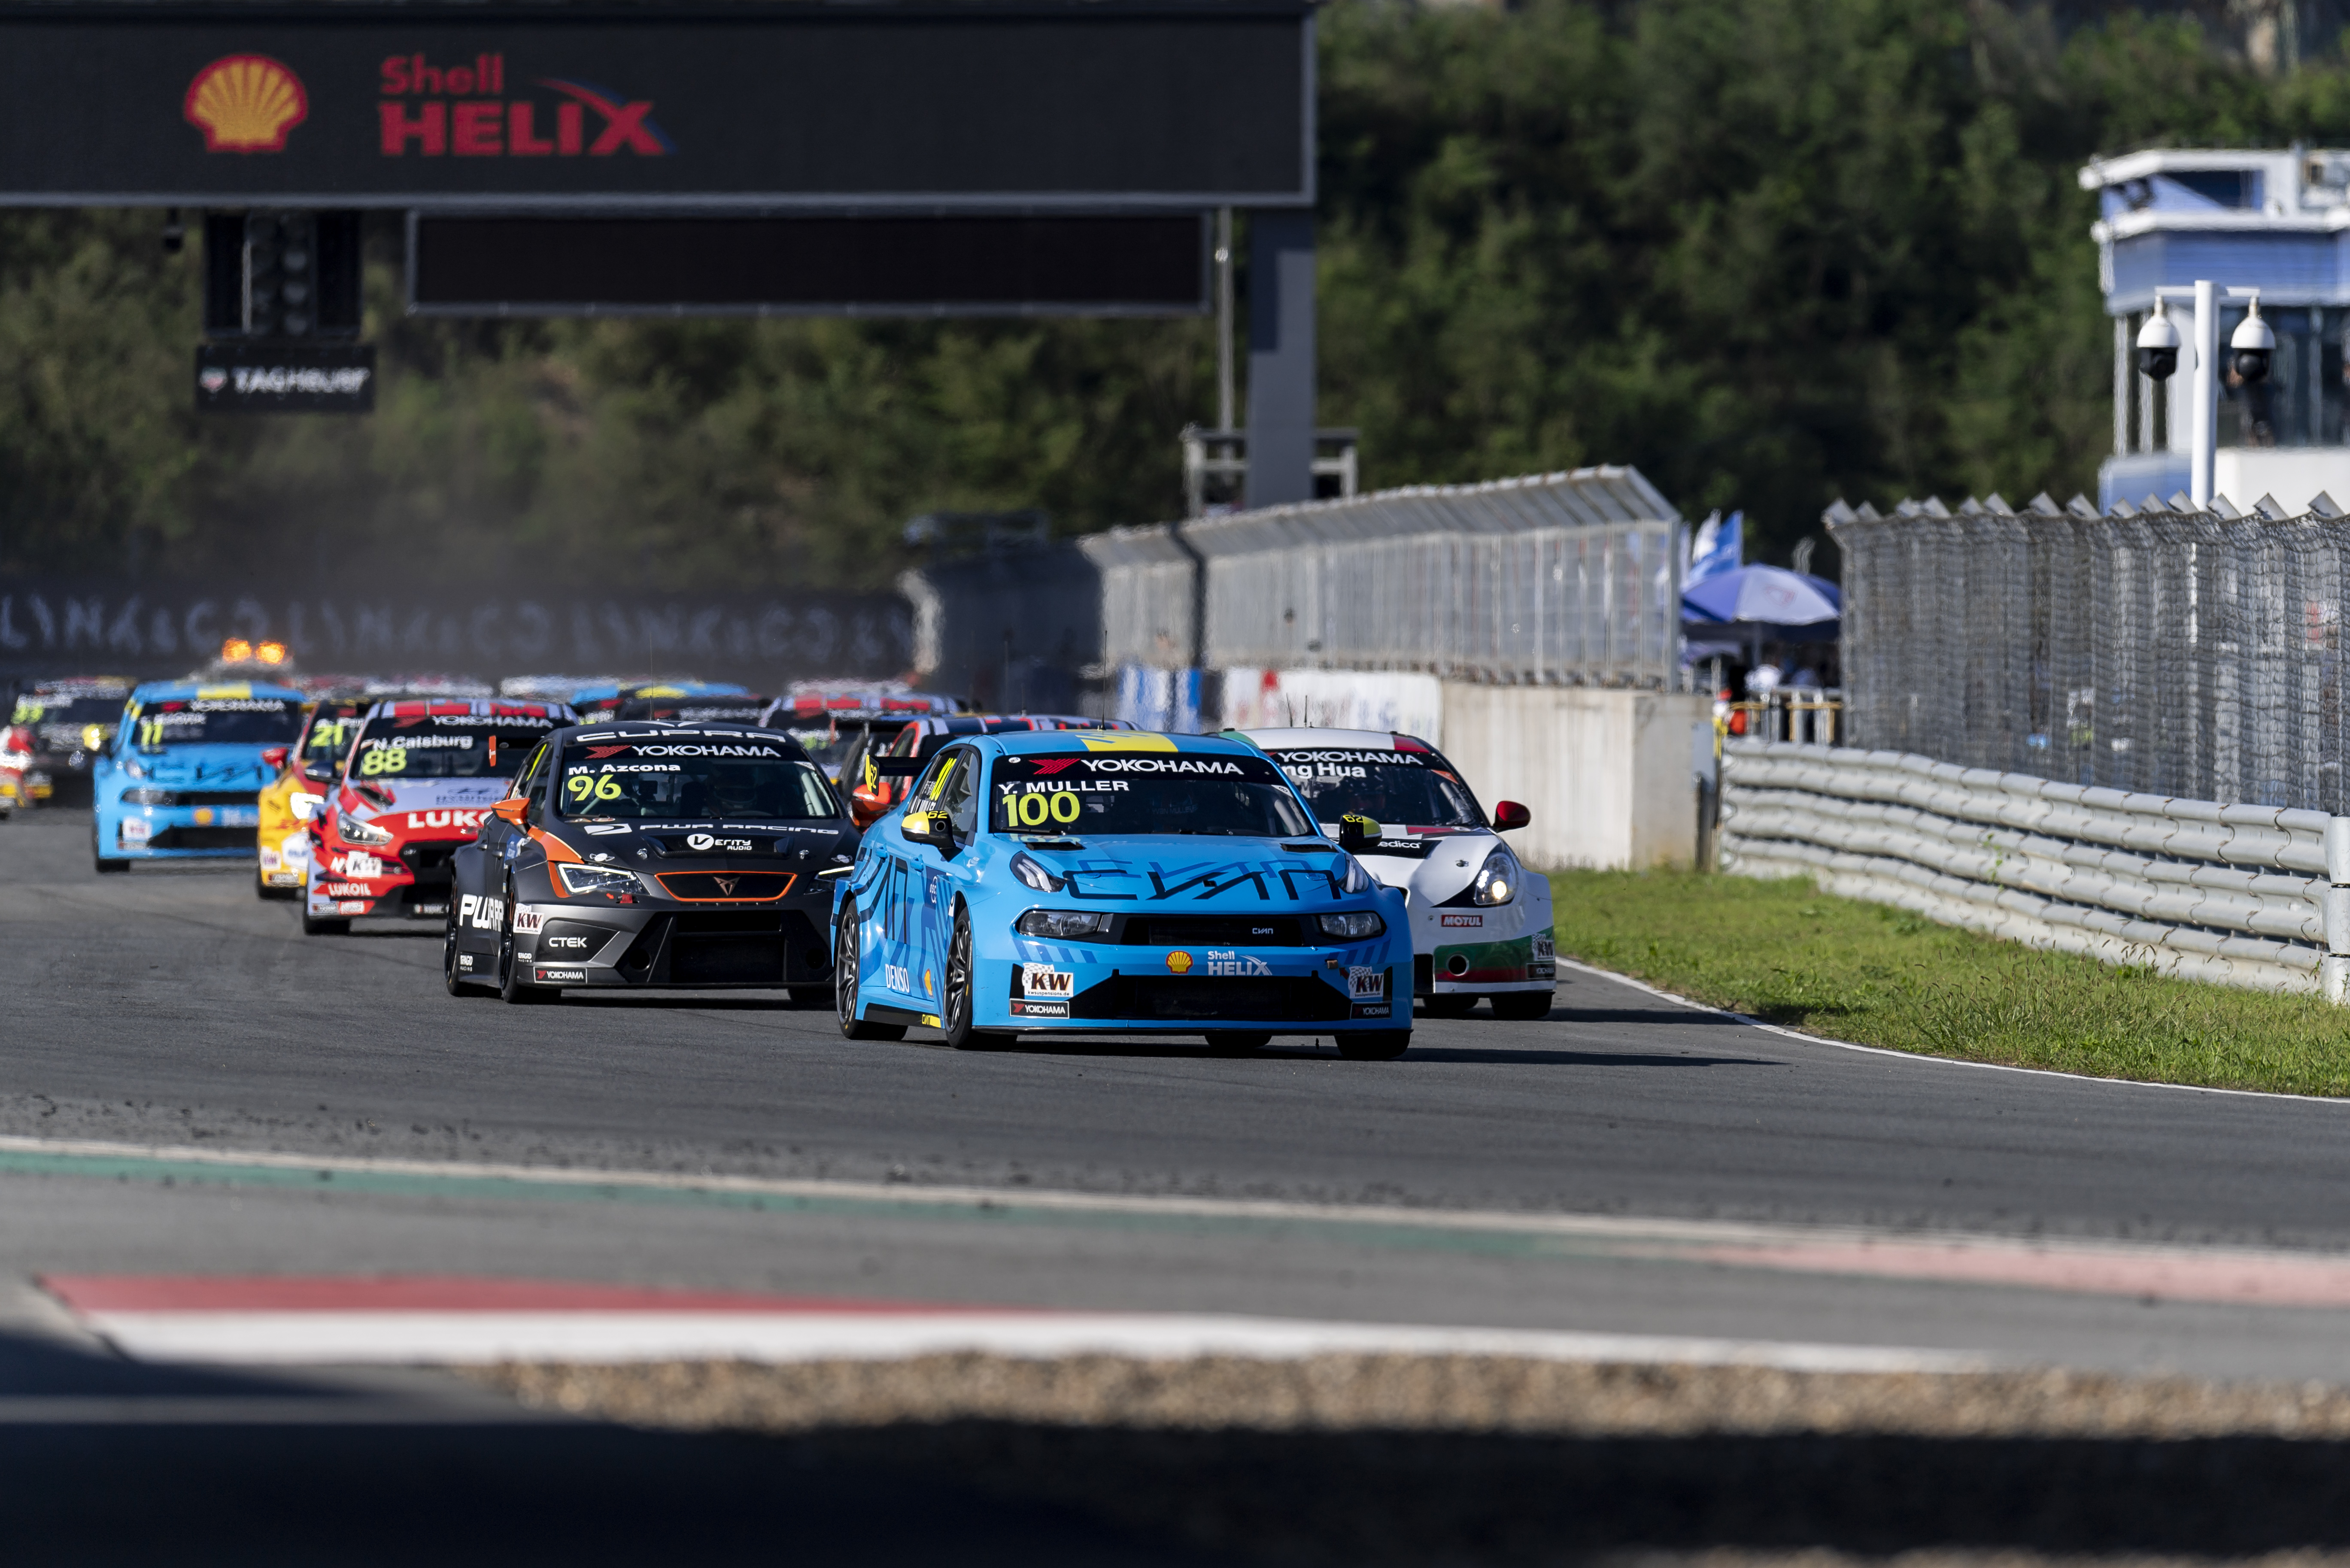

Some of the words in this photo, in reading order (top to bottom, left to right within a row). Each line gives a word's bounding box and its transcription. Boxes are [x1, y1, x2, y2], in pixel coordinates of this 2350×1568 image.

[381, 53, 504, 94] Shell
[378, 100, 668, 156] HELIX
[432, 716, 554, 728] YOKOHAMA
[310, 725, 343, 747] 21
[576, 729, 786, 743] CUPRA
[632, 745, 781, 758] YOKOHAMA
[1278, 751, 1424, 765] YOKOHAMA
[361, 748, 407, 775] 88
[1081, 759, 1245, 775] YOKOHAMA
[568, 765, 595, 775] M.
[600, 763, 681, 772] Azcona
[1317, 762, 1367, 778] Hua
[869, 764, 877, 789] 62
[567, 774, 622, 801] 96
[998, 783, 1018, 794] Y.
[1026, 780, 1130, 793] MULLER
[1002, 791, 1081, 827] 100
[1342, 815, 1364, 823] 62
[723, 824, 839, 834] RACING
[1378, 840, 1422, 849] edica
[328, 883, 371, 896] LUKOIL
[517, 913, 543, 928] KW
[1444, 916, 1481, 926] MOTUL
[549, 937, 587, 948] CTEK
[1208, 951, 1235, 960] Shell
[1207, 959, 1272, 976] HELIX
[547, 971, 584, 979] YOKOHAMA
[885, 964, 910, 993] DENSO
[1031, 972, 1072, 991] KW
[1355, 975, 1383, 993] KW
[1025, 1004, 1066, 1014] YOKOHAMA
[1363, 1007, 1389, 1015] YOKOHAMA
